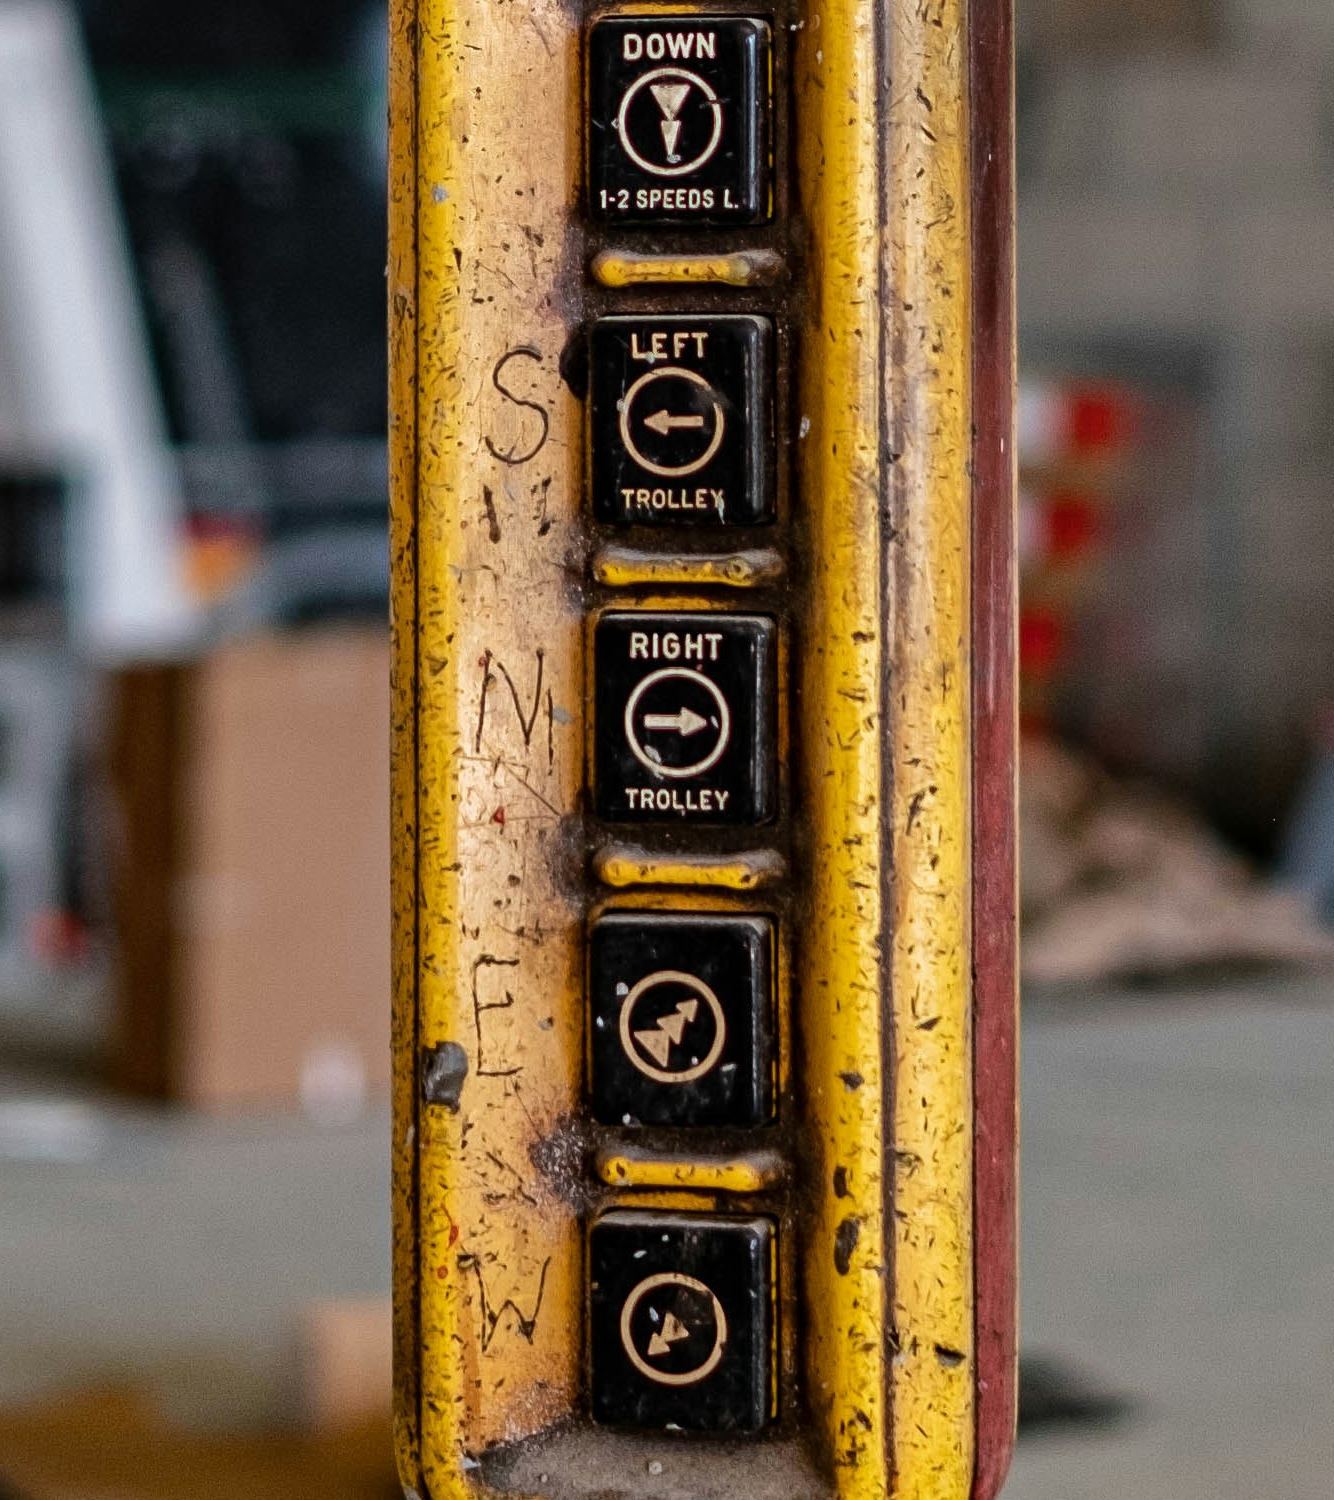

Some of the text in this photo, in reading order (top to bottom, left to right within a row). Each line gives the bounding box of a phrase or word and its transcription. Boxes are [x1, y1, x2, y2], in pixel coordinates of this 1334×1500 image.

[622, 31, 717, 62] DOWN
[598, 188, 631, 210] 1-2
[635, 187, 716, 210] SPEEDS
[629, 331, 710, 360] LEFT
[485, 345, 549, 465] S
[619, 487, 726, 511] TROLLEY
[628, 631, 724, 662] RIGHT
[624, 787, 730, 812] TROLLEY
[471, 953, 522, 1077] E
